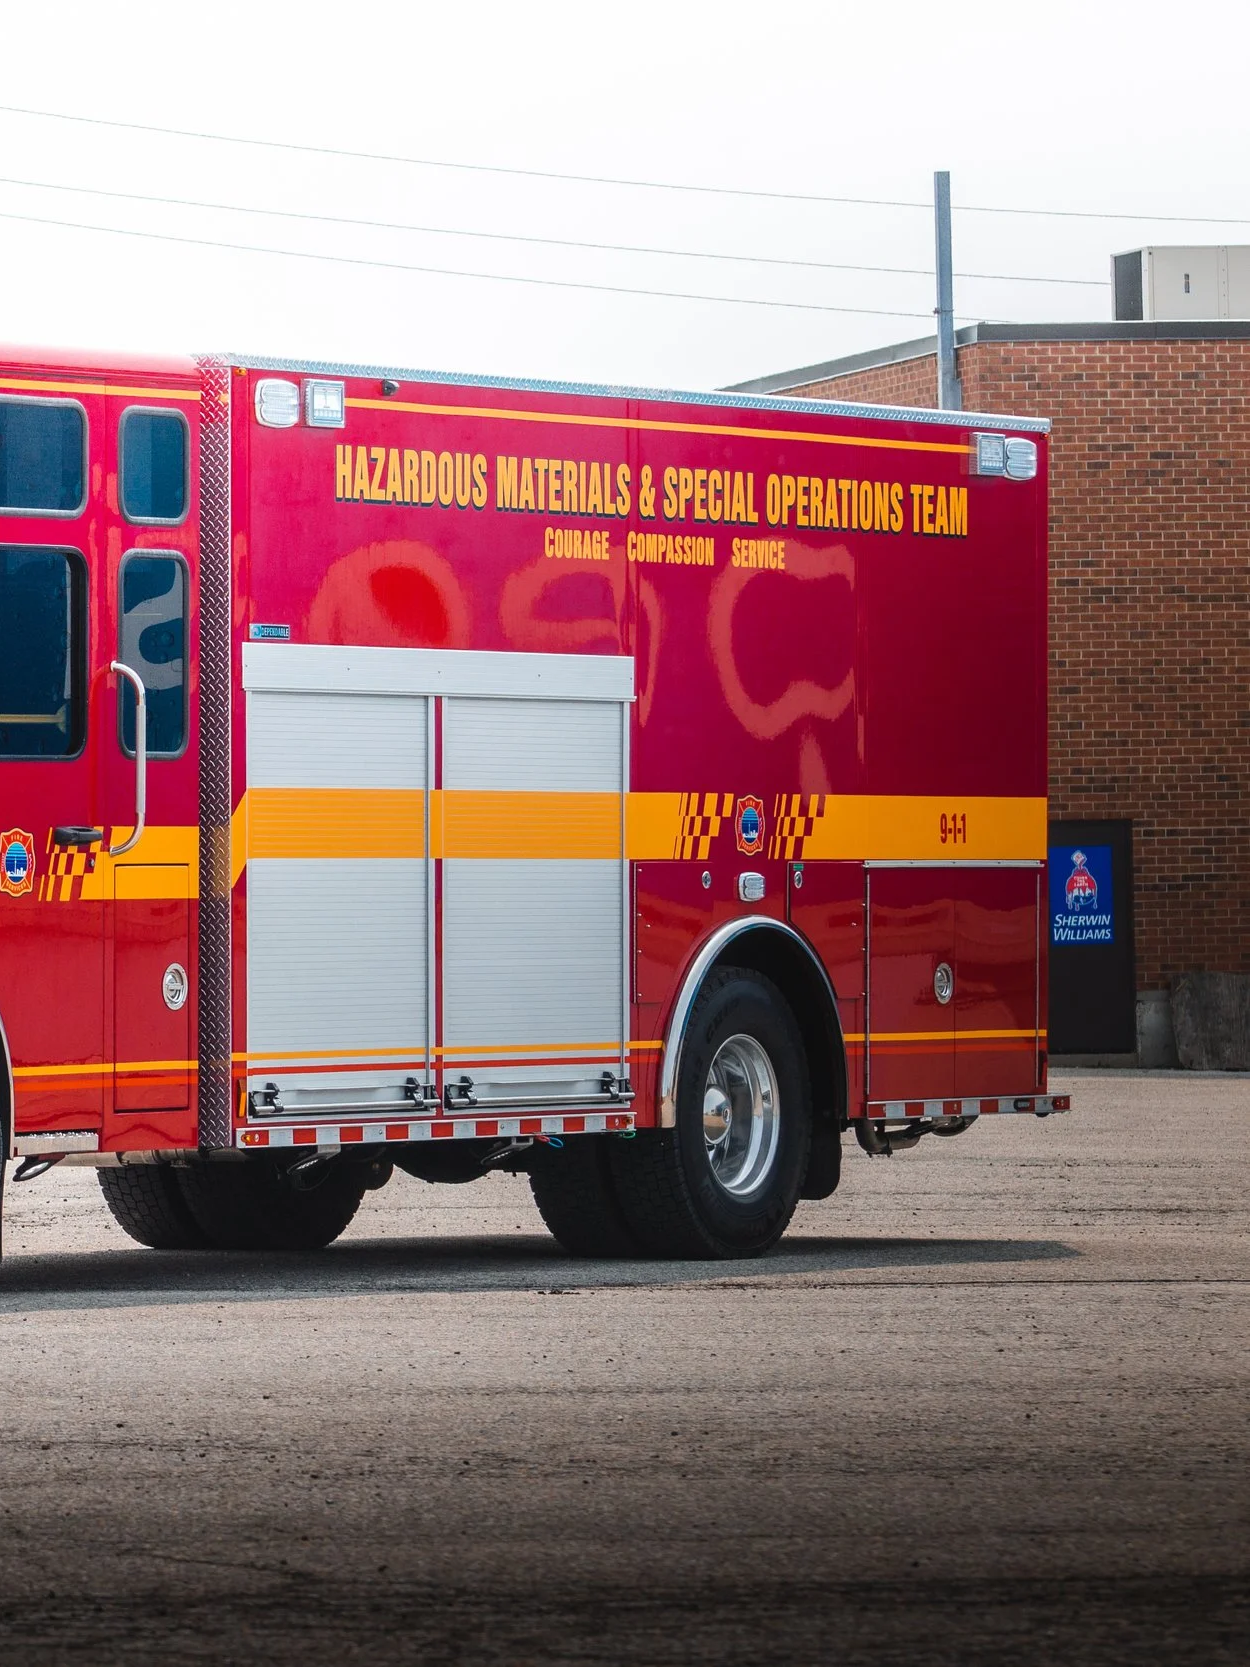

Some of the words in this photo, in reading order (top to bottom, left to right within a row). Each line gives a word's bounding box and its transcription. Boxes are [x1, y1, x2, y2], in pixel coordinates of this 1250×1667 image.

[335, 444, 488, 508] HAZARDOUS
[496, 455, 631, 519] MATERIALS
[638, 464, 656, 520] &
[663, 466, 758, 524] SPECIAL
[766, 473, 903, 533] OPERATIONS
[910, 484, 968, 537] TEAM
[544, 527, 610, 561] COURAGE
[627, 531, 715, 566] COMPASSION
[732, 537, 786, 570] SERVICE
[940, 813, 967, 844] 9-1-1
[1053, 928, 1111, 941] WILLIAMS
[1054, 914, 1111, 927] SHERWIN
